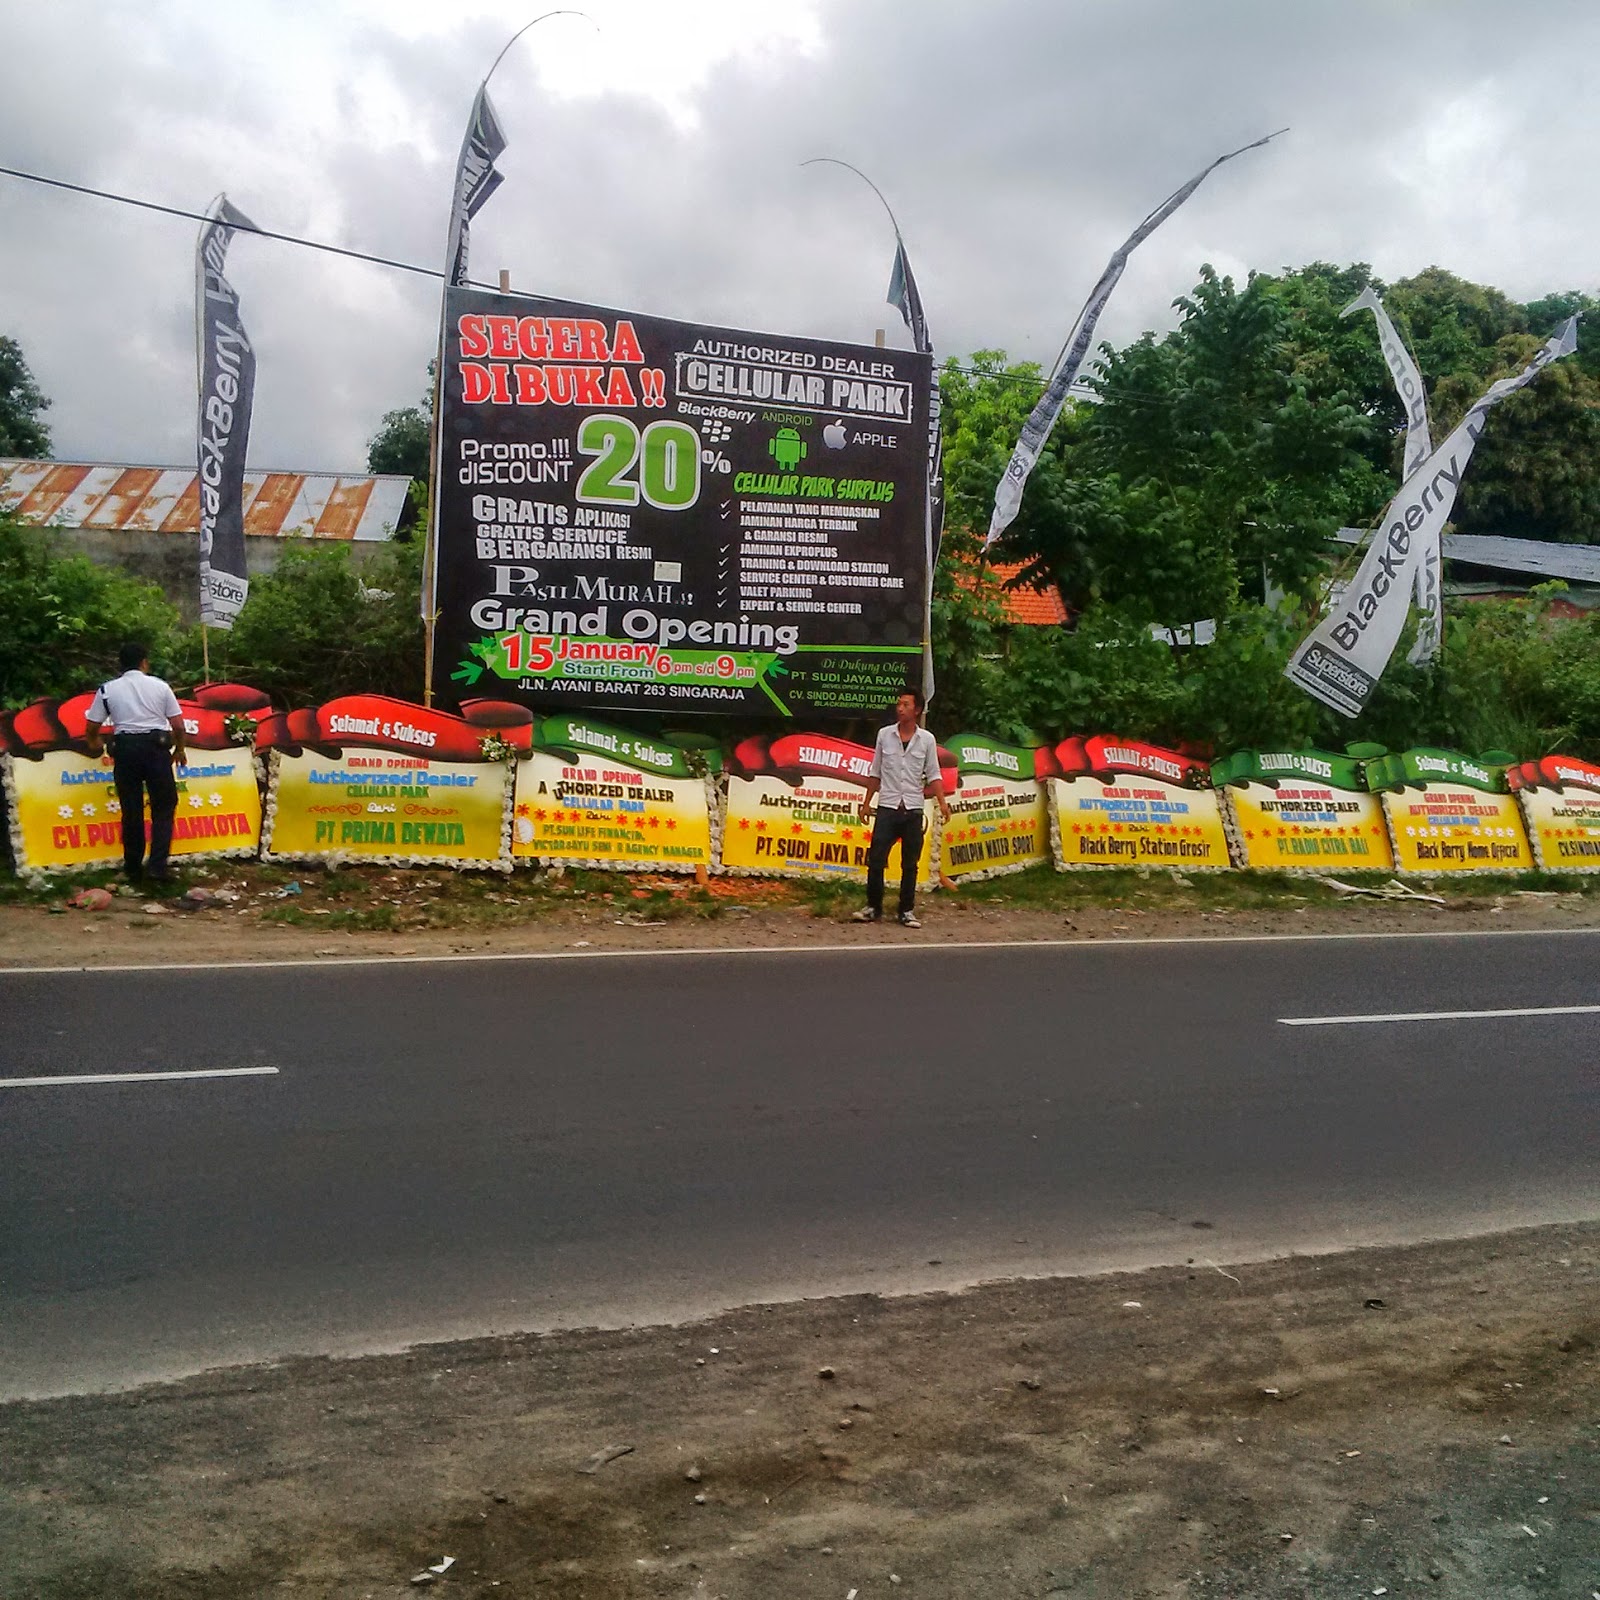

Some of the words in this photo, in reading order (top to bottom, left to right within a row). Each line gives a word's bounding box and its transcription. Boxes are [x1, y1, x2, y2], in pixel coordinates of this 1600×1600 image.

[458, 313, 644, 363] SEGERA
[693, 339, 816, 368] AUTHORIZED
[822, 357, 894, 378] DEALER
[459, 362, 512, 405] DI
[514, 364, 637, 407] BUKA
[687, 360, 825, 405] CELLULAR
[832, 379, 904, 415] PARK
[677, 401, 757, 424] BlackBerry
[762, 412, 813, 426] ANDROID
[852, 431, 897, 448] APPLE
[575, 414, 702, 511] 20
[701, 450, 731, 474] %
[734, 472, 799, 495] CELLULAR
[800, 476, 835, 498] PARK
[837, 479, 895, 502] SURPLUS
[472, 494, 568, 525] GRATIS
[574, 508, 631, 528] APLIKASI
[740, 501, 793, 515] PELAYANAN
[794, 503, 819, 516] YANG
[821, 505, 880, 518] MEMUASKAN
[477, 524, 544, 541] GRATIS
[552, 527, 627, 544] SERVICE
[740, 515, 783, 528] JAMINAN
[784, 517, 817, 530] HARGA
[818, 519, 858, 531] TERBAIK
[754, 530, 796, 543] GARANSI
[798, 532, 828, 543] RESMI
[476, 538, 610, 559] BERGARANSI
[616, 547, 652, 560] RESMI
[740, 544, 783, 556] JAMINAN
[1330, 455, 1460, 652] BlackBerry
[740, 558, 786, 570] TRAINING
[797, 559, 850, 573] DOWNLOAD
[851, 562, 889, 574] STATION
[571, 575, 672, 604] MURAH
[740, 571, 781, 584] SERVICE
[782, 573, 818, 586] CENTER
[828, 575, 879, 588] CUSTOMER
[880, 577, 904, 588] CARE
[740, 586, 769, 598] VALET
[770, 587, 812, 599] PARKING
[740, 600, 775, 612] EXPERT
[786, 600, 825, 613] SERVICE
[827, 602, 862, 614] CENTER
[470, 598, 608, 636] Grand
[621, 609, 799, 655] Opening
[501, 633, 555, 672] 15
[557, 637, 660, 666] January
[563, 662, 607, 677] Start
[610, 664, 655, 679] From
[656, 655, 672, 676] 6
[674, 663, 693, 675] pm
[695, 663, 715, 676] s/d
[716, 655, 735, 678] 9
[736, 666, 755, 678] pm
[518, 678, 548, 691] JLN.
[551, 679, 591, 693] AYANI
[595, 681, 639, 696] BARAT
[643, 683, 666, 697] 263
[669, 685, 745, 701] SINGARAJA
[811, 672, 840, 682] SUDI
[842, 674, 873, 684] JAYA
[875, 676, 906, 687] RAYA
[807, 691, 836, 700] SINDO
[838, 693, 867, 703] ABADI
[329, 714, 379, 737] Selamat
[391, 721, 437, 748] Sukses
[567, 723, 618, 753] Selamat
[633, 741, 673, 767] Sukses
[348, 757, 383, 769] GRAND
[387, 758, 430, 770] OPENING
[799, 746, 843, 769] SELAMAT
[308, 769, 412, 786] Authorized
[416, 771, 478, 787] Dealer
[627, 786, 674, 802] DEALER
[760, 793, 852, 814] Authorized
[1259, 801, 1323, 813] AUTHORIZED
[1325, 802, 1360, 813] DEALER
[341, 821, 396, 845] PRIMA
[815, 842, 849, 864] JAYA
[1140, 838, 1178, 857] Station
